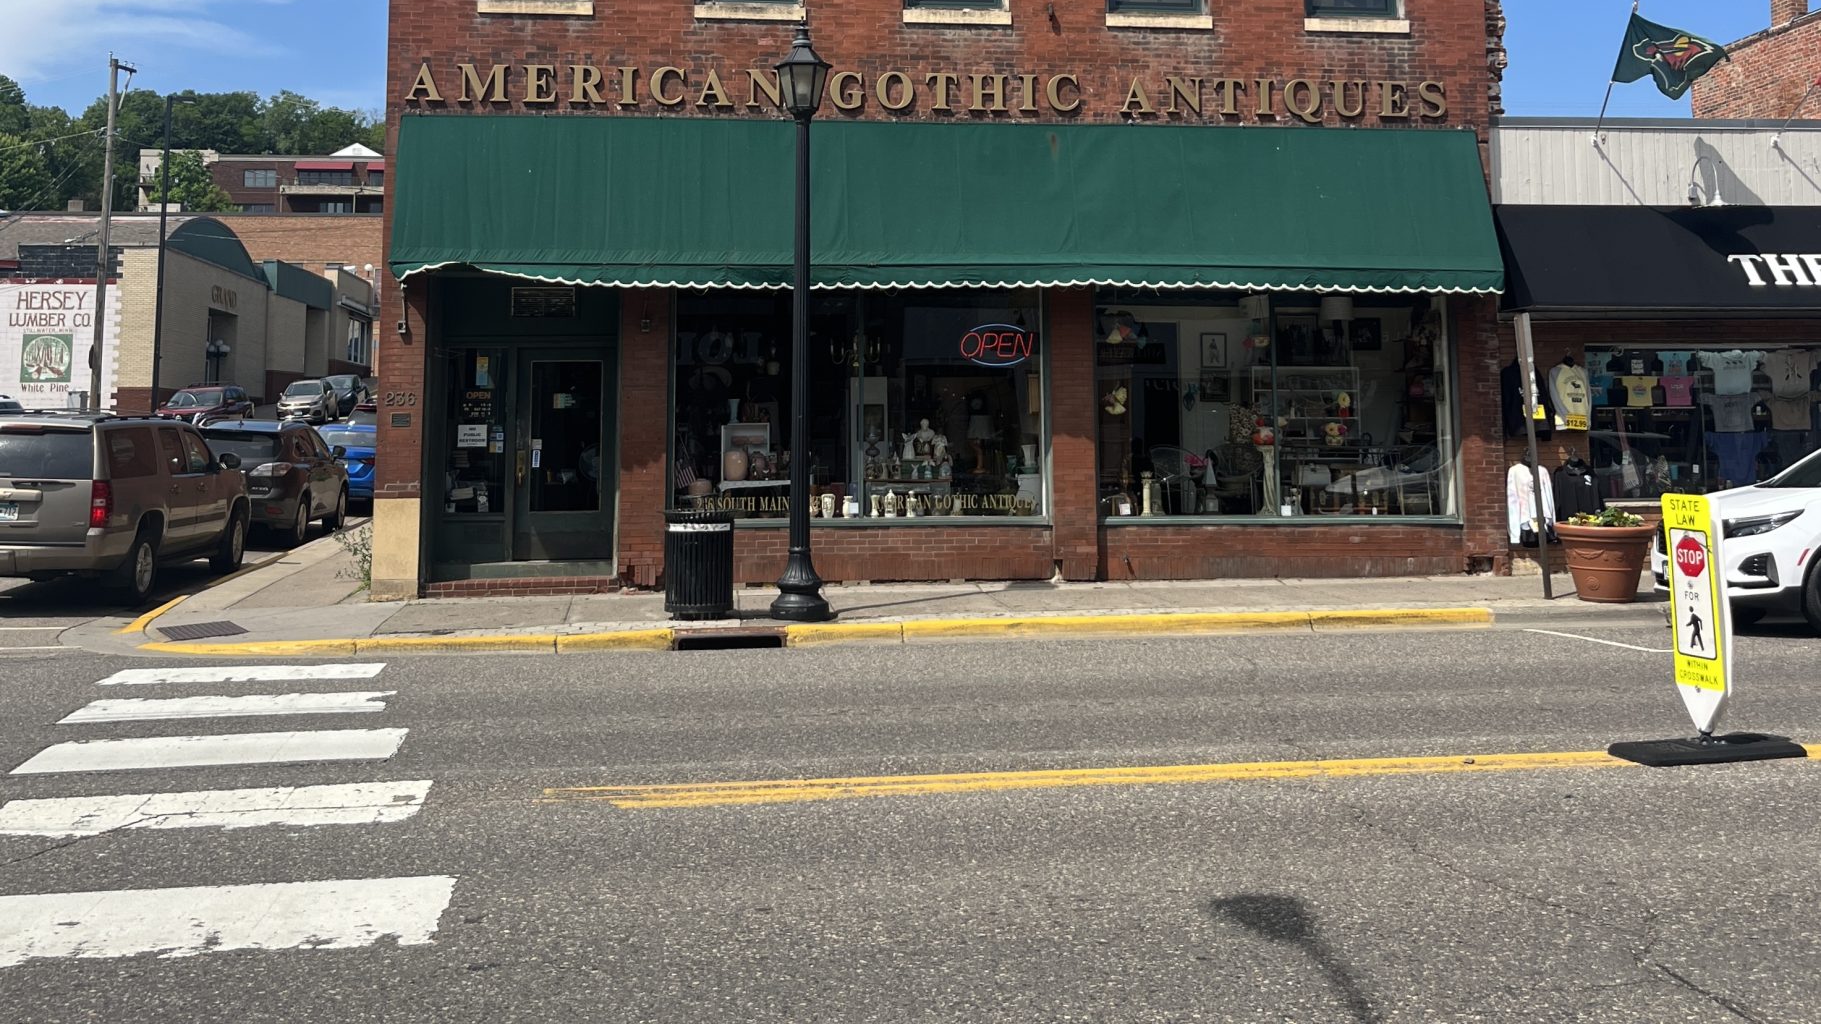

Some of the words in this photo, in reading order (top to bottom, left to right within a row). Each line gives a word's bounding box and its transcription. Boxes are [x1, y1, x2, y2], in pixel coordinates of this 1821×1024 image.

[404, 62, 783, 108] AMERICAN
[829, 71, 1081, 112] GOTHIC
[1119, 76, 1447, 123] ANTIQUES
[16, 291, 88, 310] HERSEY
[9, 313, 66, 327] LUMBER
[73, 313, 92, 327] CO.
[961, 332, 1033, 357] OPEN
[21, 383, 45, 392] White
[50, 383, 70, 392] Pine
[385, 391, 417, 406] 236
[466, 391, 491, 399] OPEN
[1566, 420, 1587, 428] $12.99
[717, 496, 756, 511] SOUTH
[760, 496, 790, 512] MAIN
[1670, 499, 1700, 512] STATE
[1676, 514, 1695, 526] LAW
[1677, 548, 1704, 565] STOP
[1685, 591, 1700, 601] FOR
[1687, 660, 1709, 671] WITHIN
[1679, 669, 1719, 685] CROSSWALK
